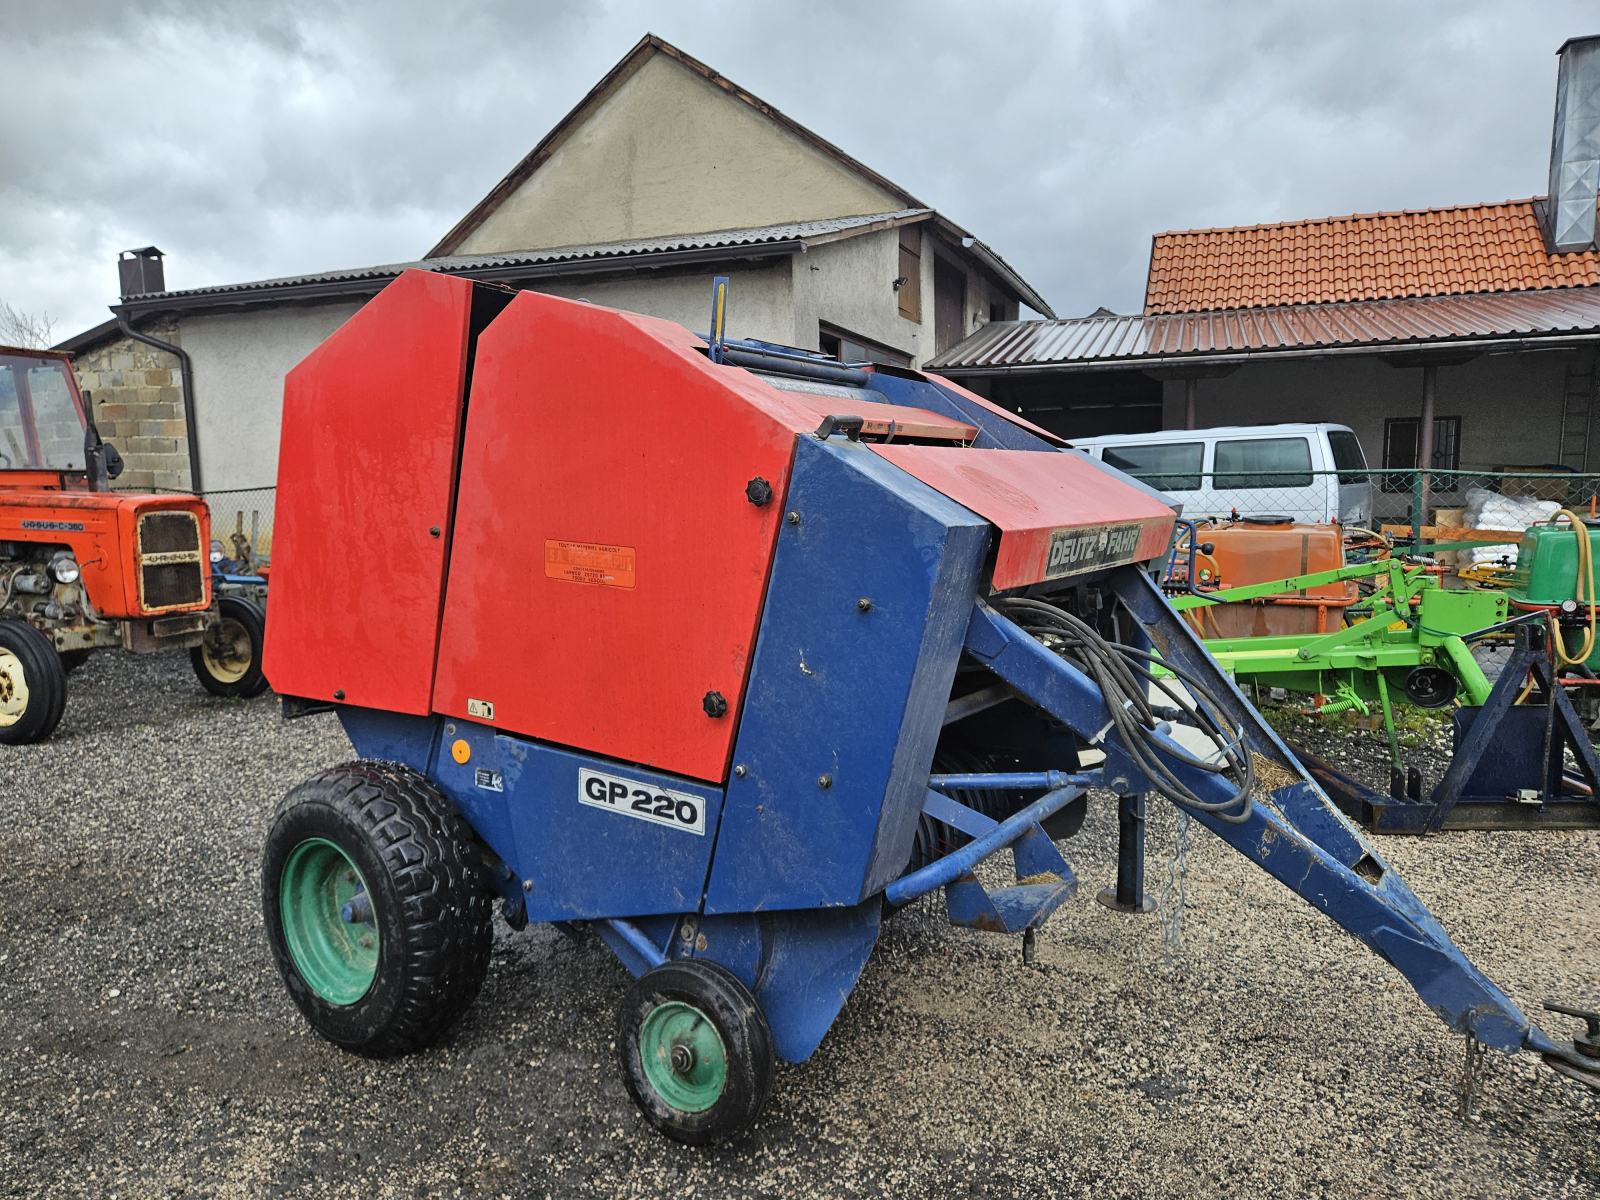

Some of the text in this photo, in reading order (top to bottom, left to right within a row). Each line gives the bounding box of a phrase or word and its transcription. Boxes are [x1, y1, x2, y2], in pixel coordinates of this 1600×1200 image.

[1049, 528, 1141, 567] DEUTZ FAHR
[585, 777, 698, 825] GP 220
